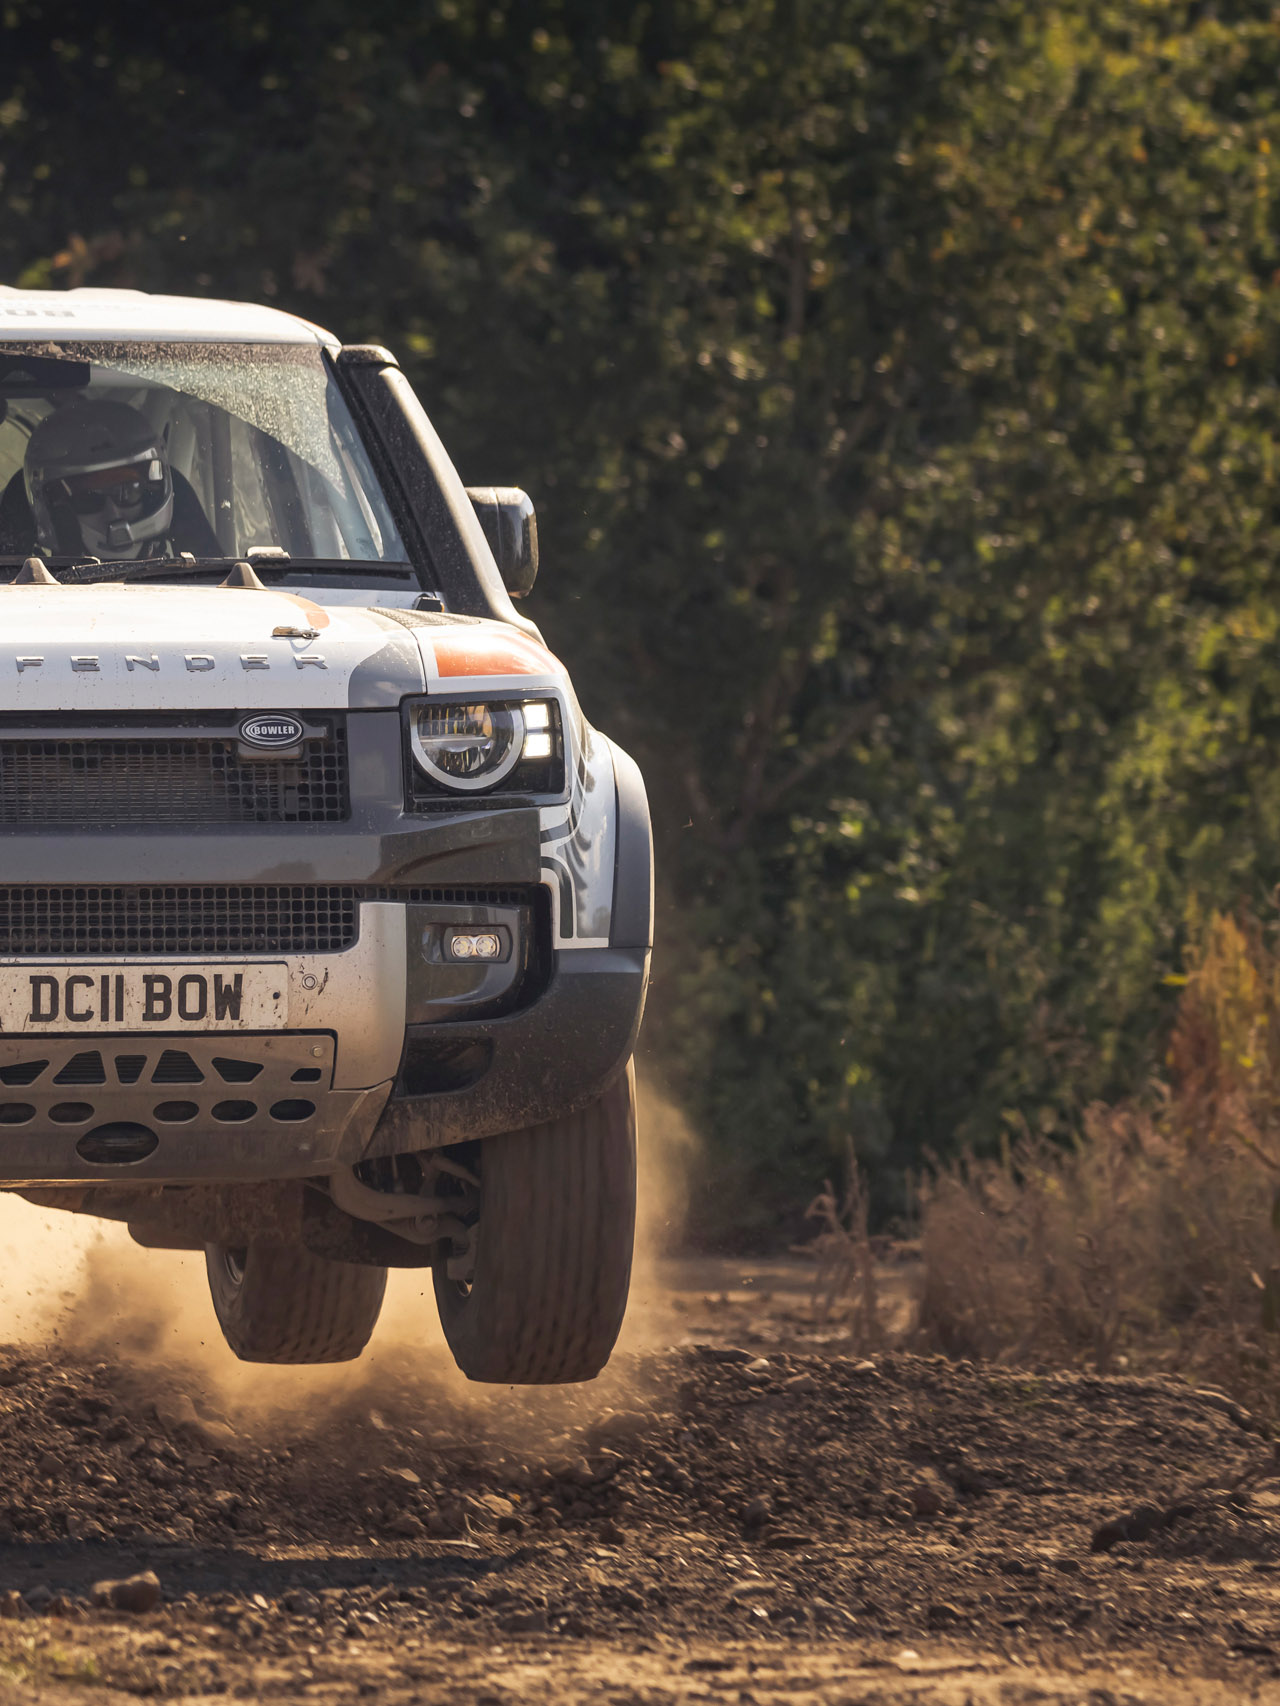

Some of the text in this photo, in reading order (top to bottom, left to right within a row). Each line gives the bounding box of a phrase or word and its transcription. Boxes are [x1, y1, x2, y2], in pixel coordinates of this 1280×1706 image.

[254, 725, 295, 735] BOWLER
[29, 973, 243, 1023] DC11 BOW
